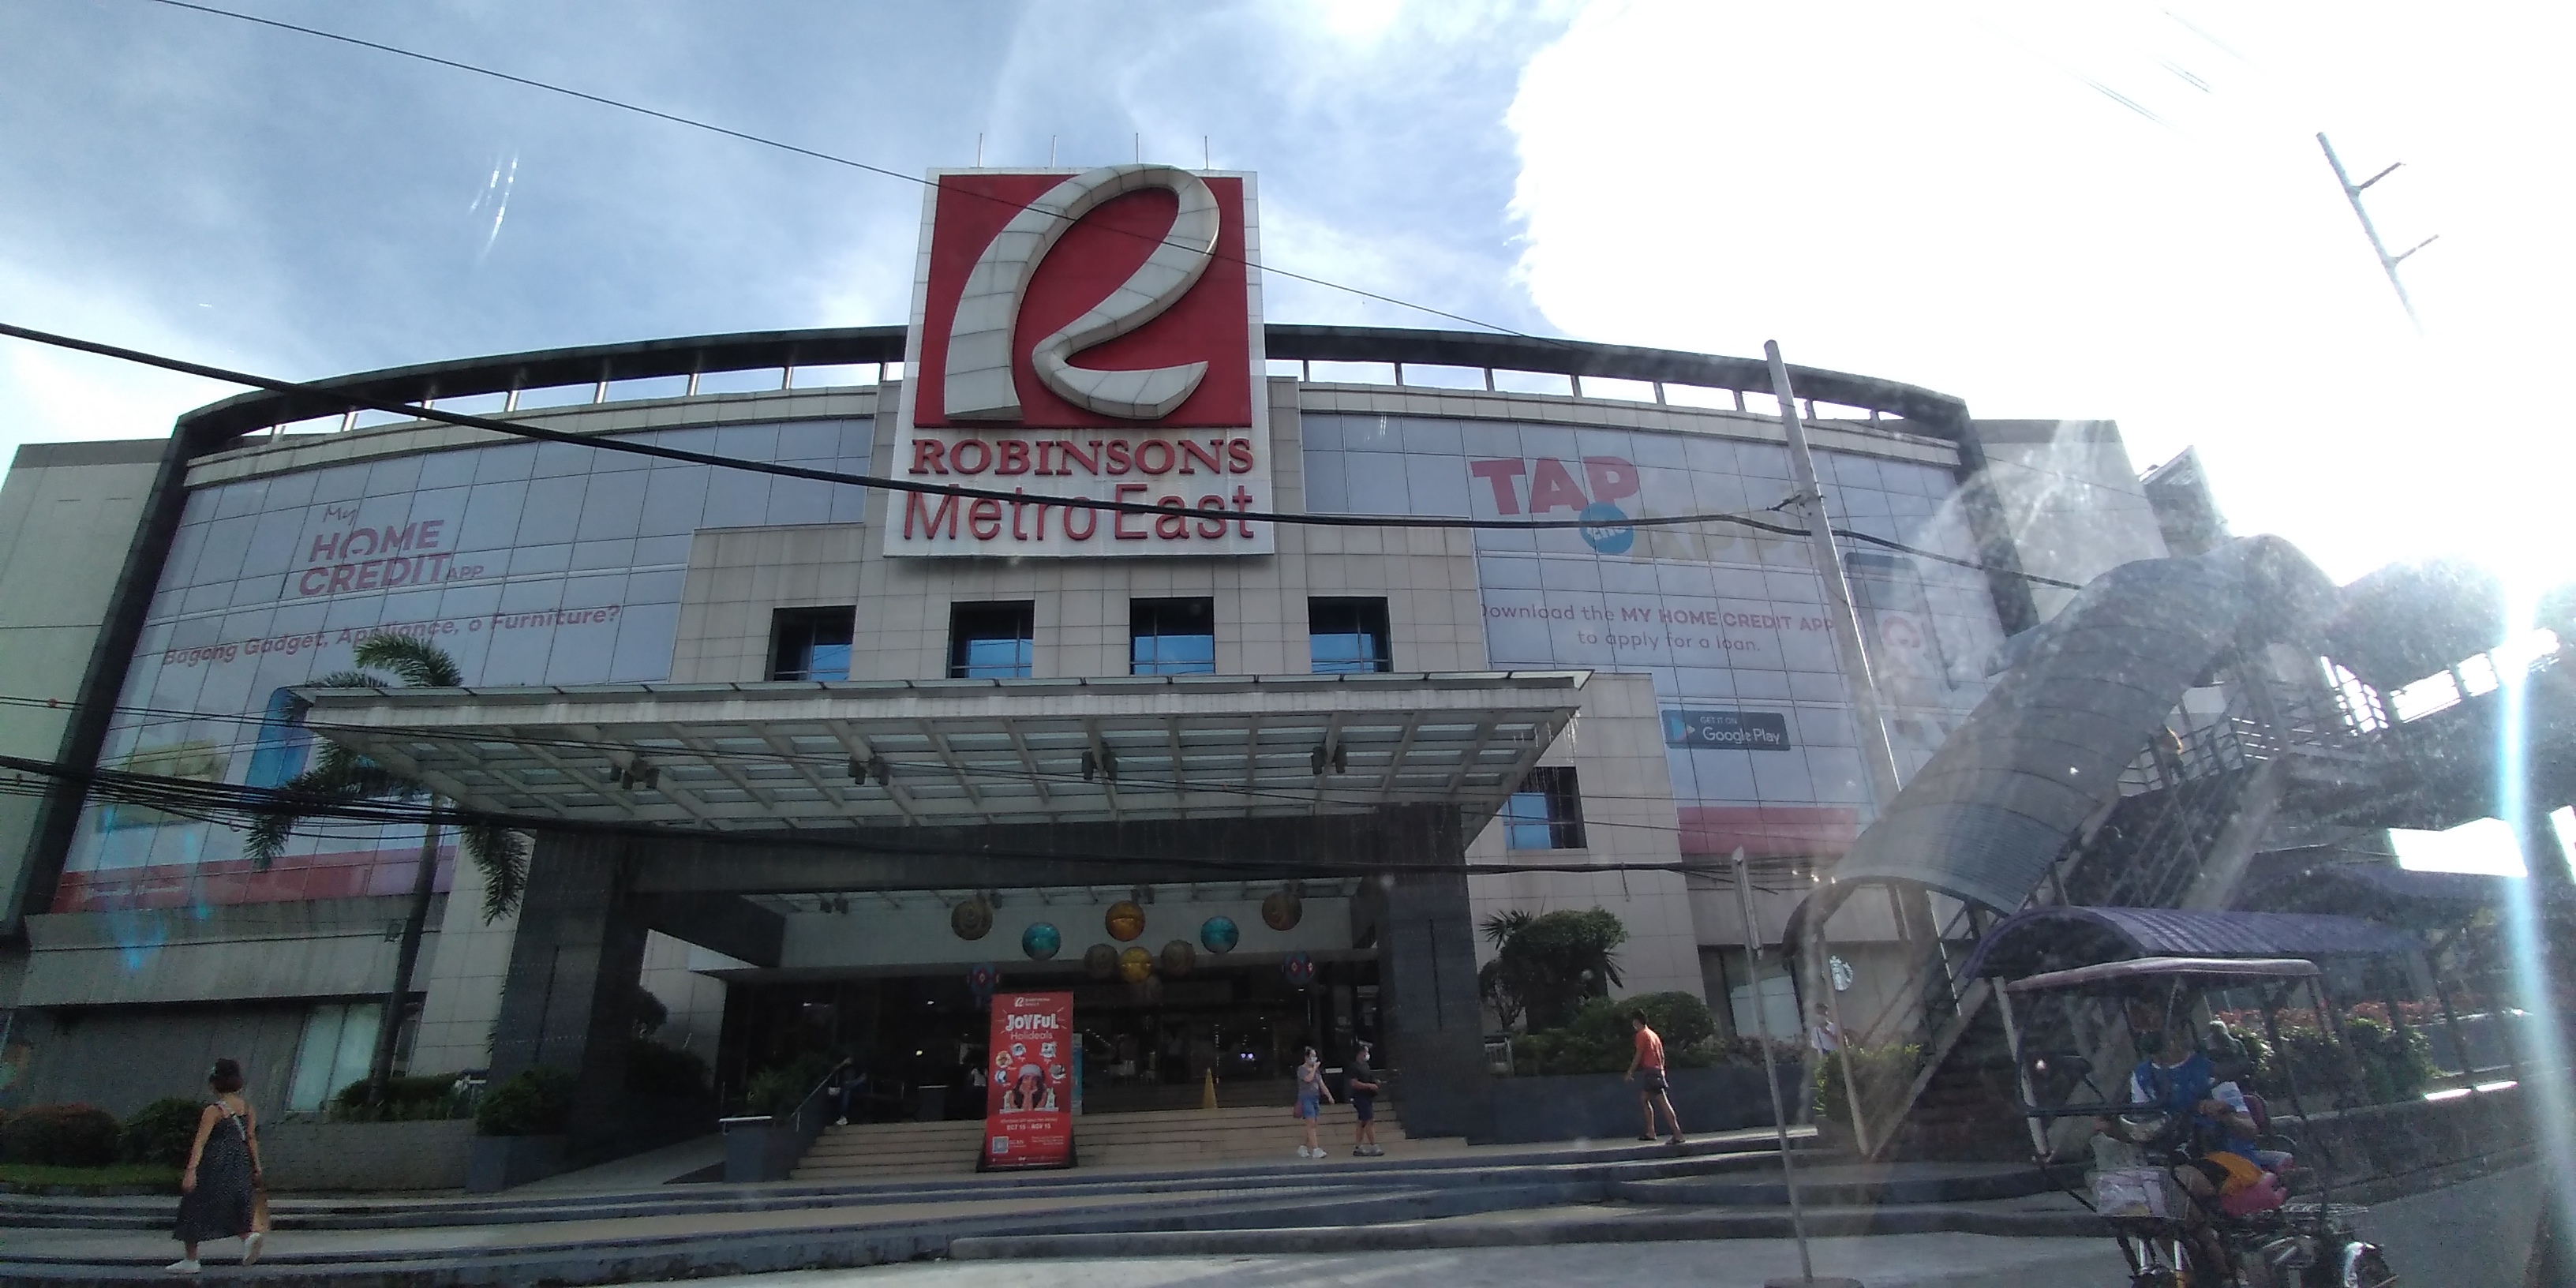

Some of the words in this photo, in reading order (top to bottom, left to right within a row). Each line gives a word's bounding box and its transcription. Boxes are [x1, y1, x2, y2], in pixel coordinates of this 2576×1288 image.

[908, 437, 1254, 476] ROBINSONS
[1470, 455, 1640, 515] TAP
[322, 504, 357, 526] My
[308, 519, 444, 563] HOME
[298, 551, 453, 597] CREDIT
[447, 564, 485, 580] APP
[244, 634, 328, 656] Gadget,
[490, 605, 621, 631] Furniture?
[1581, 605, 1615, 621] the
[1621, 607, 1651, 623] MY
[1658, 608, 1718, 626] HOME
[1723, 612, 1792, 630] CREDIT
[1577, 631, 1597, 645] to
[1605, 631, 1658, 651] apply
[1667, 632, 1692, 648] for
[1698, 636, 1710, 648] a
[1717, 635, 1761, 652] loan.
[1702, 726, 1752, 744] Google
[1752, 727, 1780, 745] Play
